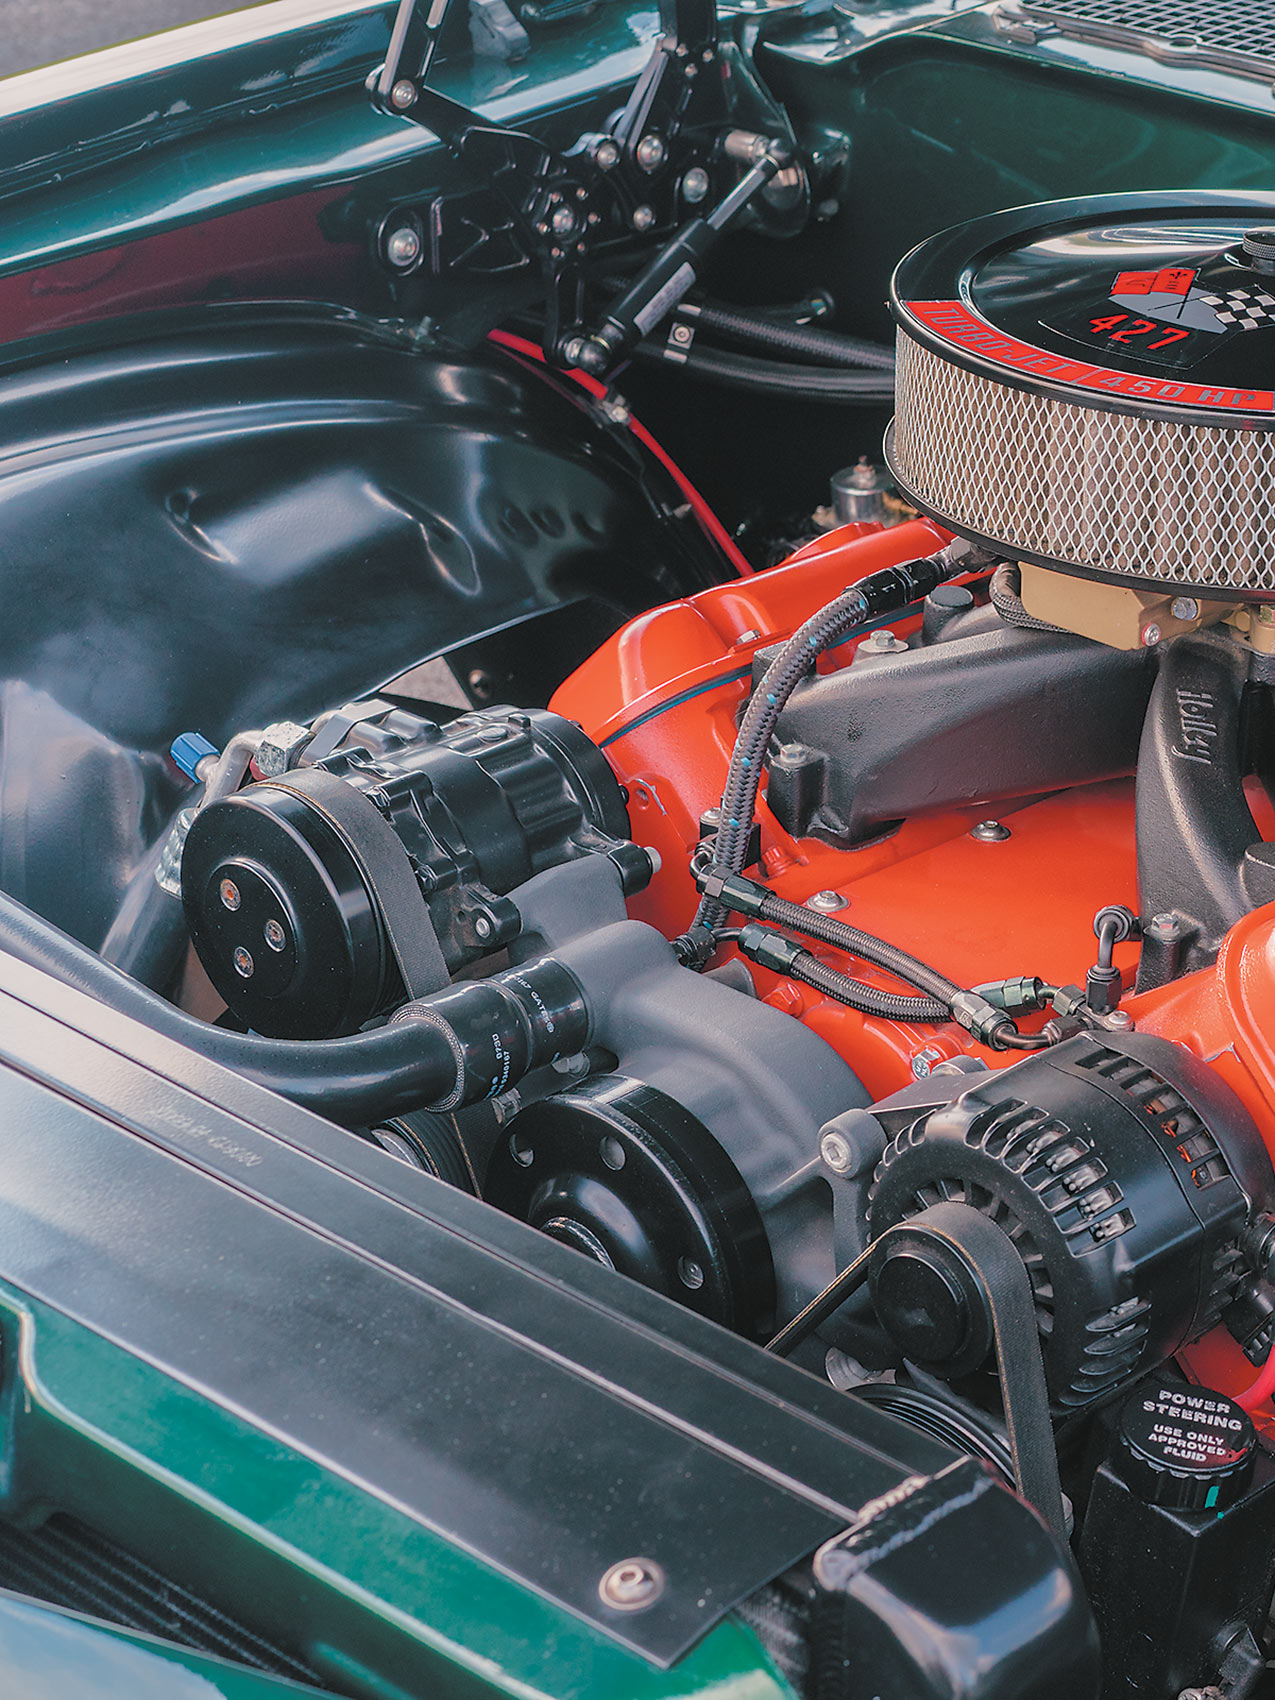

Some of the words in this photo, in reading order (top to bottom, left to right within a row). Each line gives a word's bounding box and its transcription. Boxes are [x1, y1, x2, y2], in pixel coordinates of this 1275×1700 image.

[1089, 314, 1190, 350] 427
[923, 307, 1077, 374] TURBO-JET
[1099, 375, 1186, 399] 450
[1197, 389, 1256, 406] HP
[1171, 688, 1217, 764] Holley
[1142, 1400, 1243, 1431] STEERING
[1158, 1389, 1231, 1414] POWER
[1148, 1433, 1227, 1456] APPROVED
[1153, 1423, 1183, 1438] USE
[1186, 1431, 1225, 1446] ONLY
[1163, 1446, 1207, 1462] FLUID
